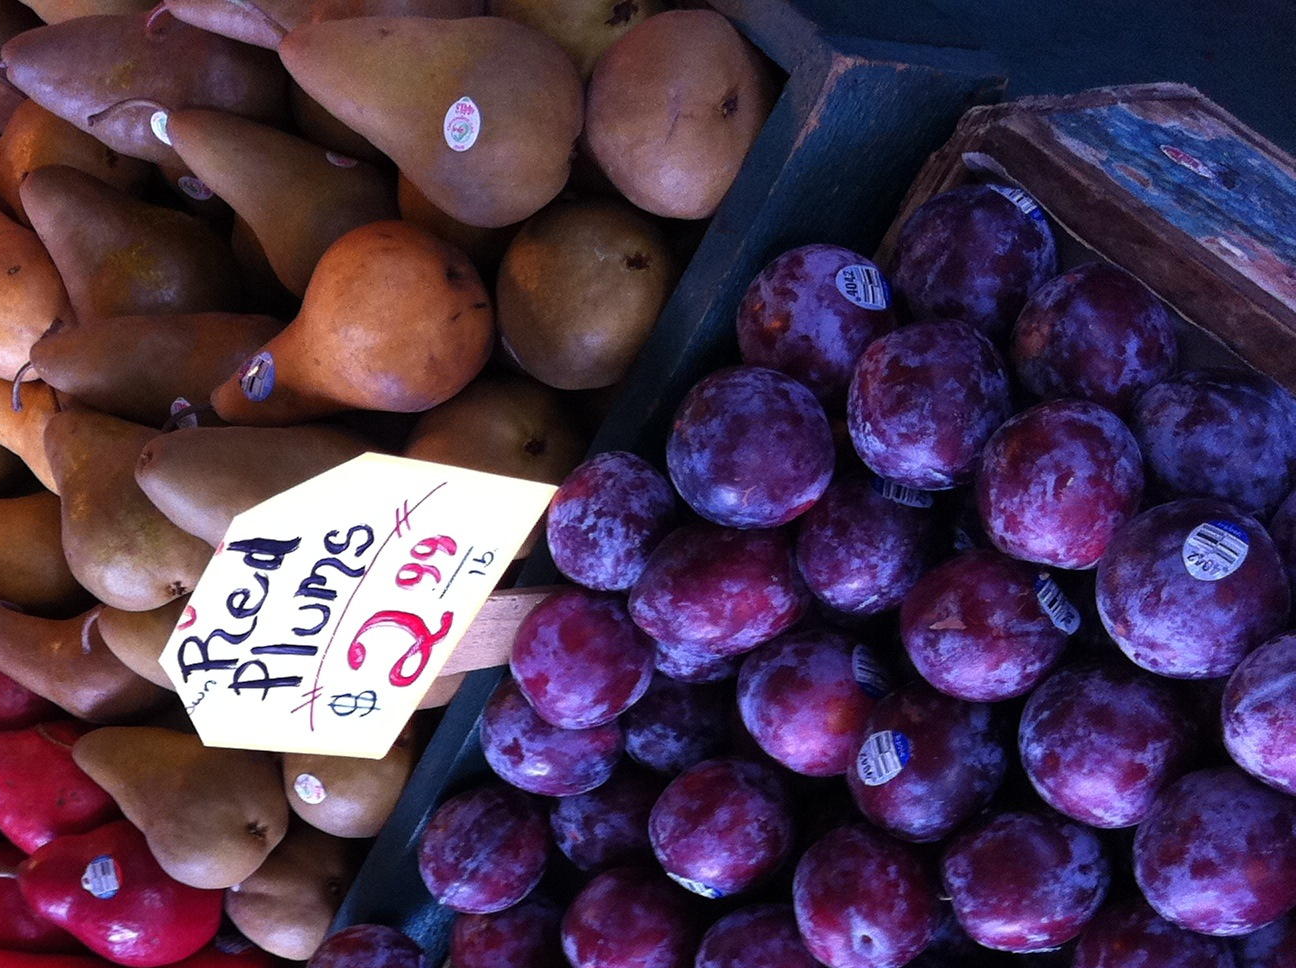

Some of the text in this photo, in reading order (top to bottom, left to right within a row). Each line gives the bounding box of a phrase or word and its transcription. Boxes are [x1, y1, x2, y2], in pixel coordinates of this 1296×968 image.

[843, 270, 858, 296] 4042
[177, 537, 302, 683] Red
[228, 523, 374, 700] Plums
